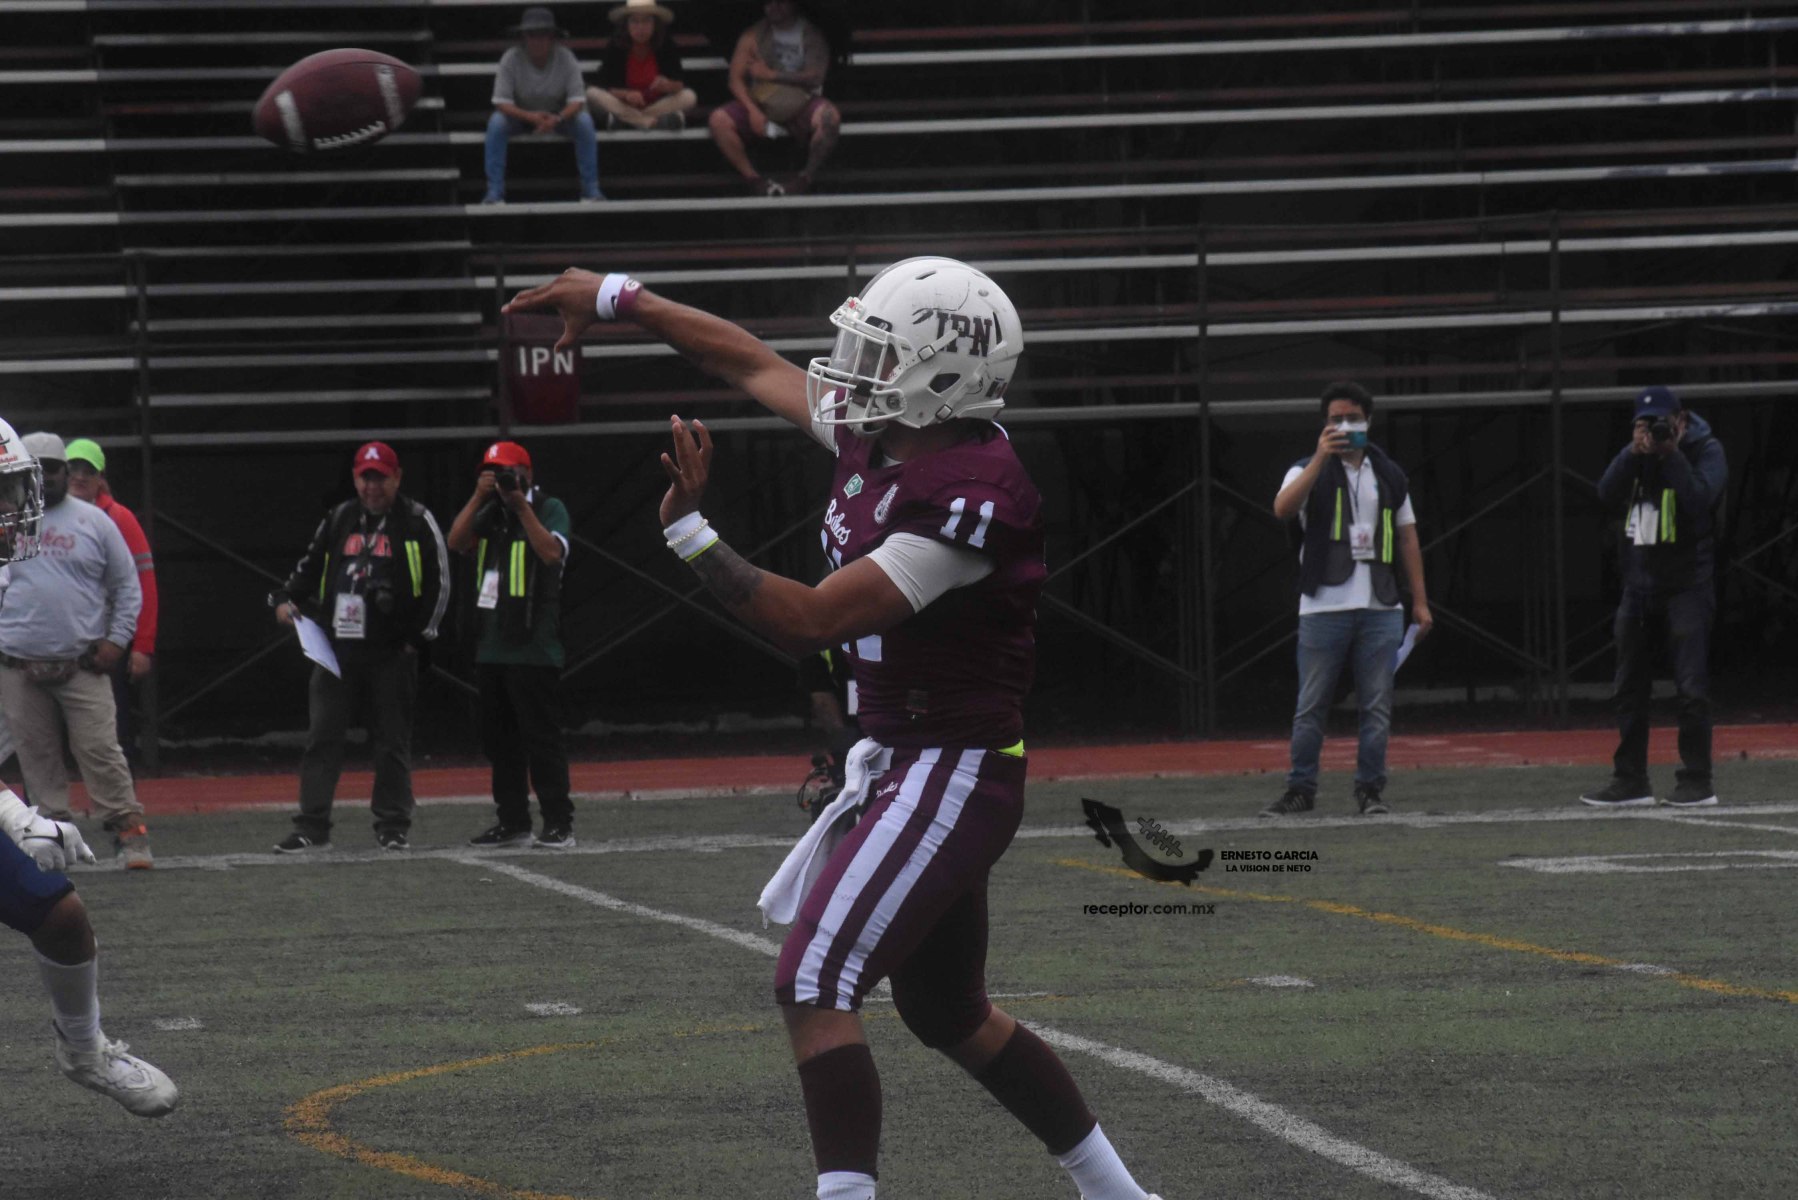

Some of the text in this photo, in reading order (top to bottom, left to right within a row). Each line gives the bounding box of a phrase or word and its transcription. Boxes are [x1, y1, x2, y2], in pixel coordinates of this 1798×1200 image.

[519, 345, 575, 376] IPN
[364, 446, 380, 460] A
[939, 497, 995, 549] 11
